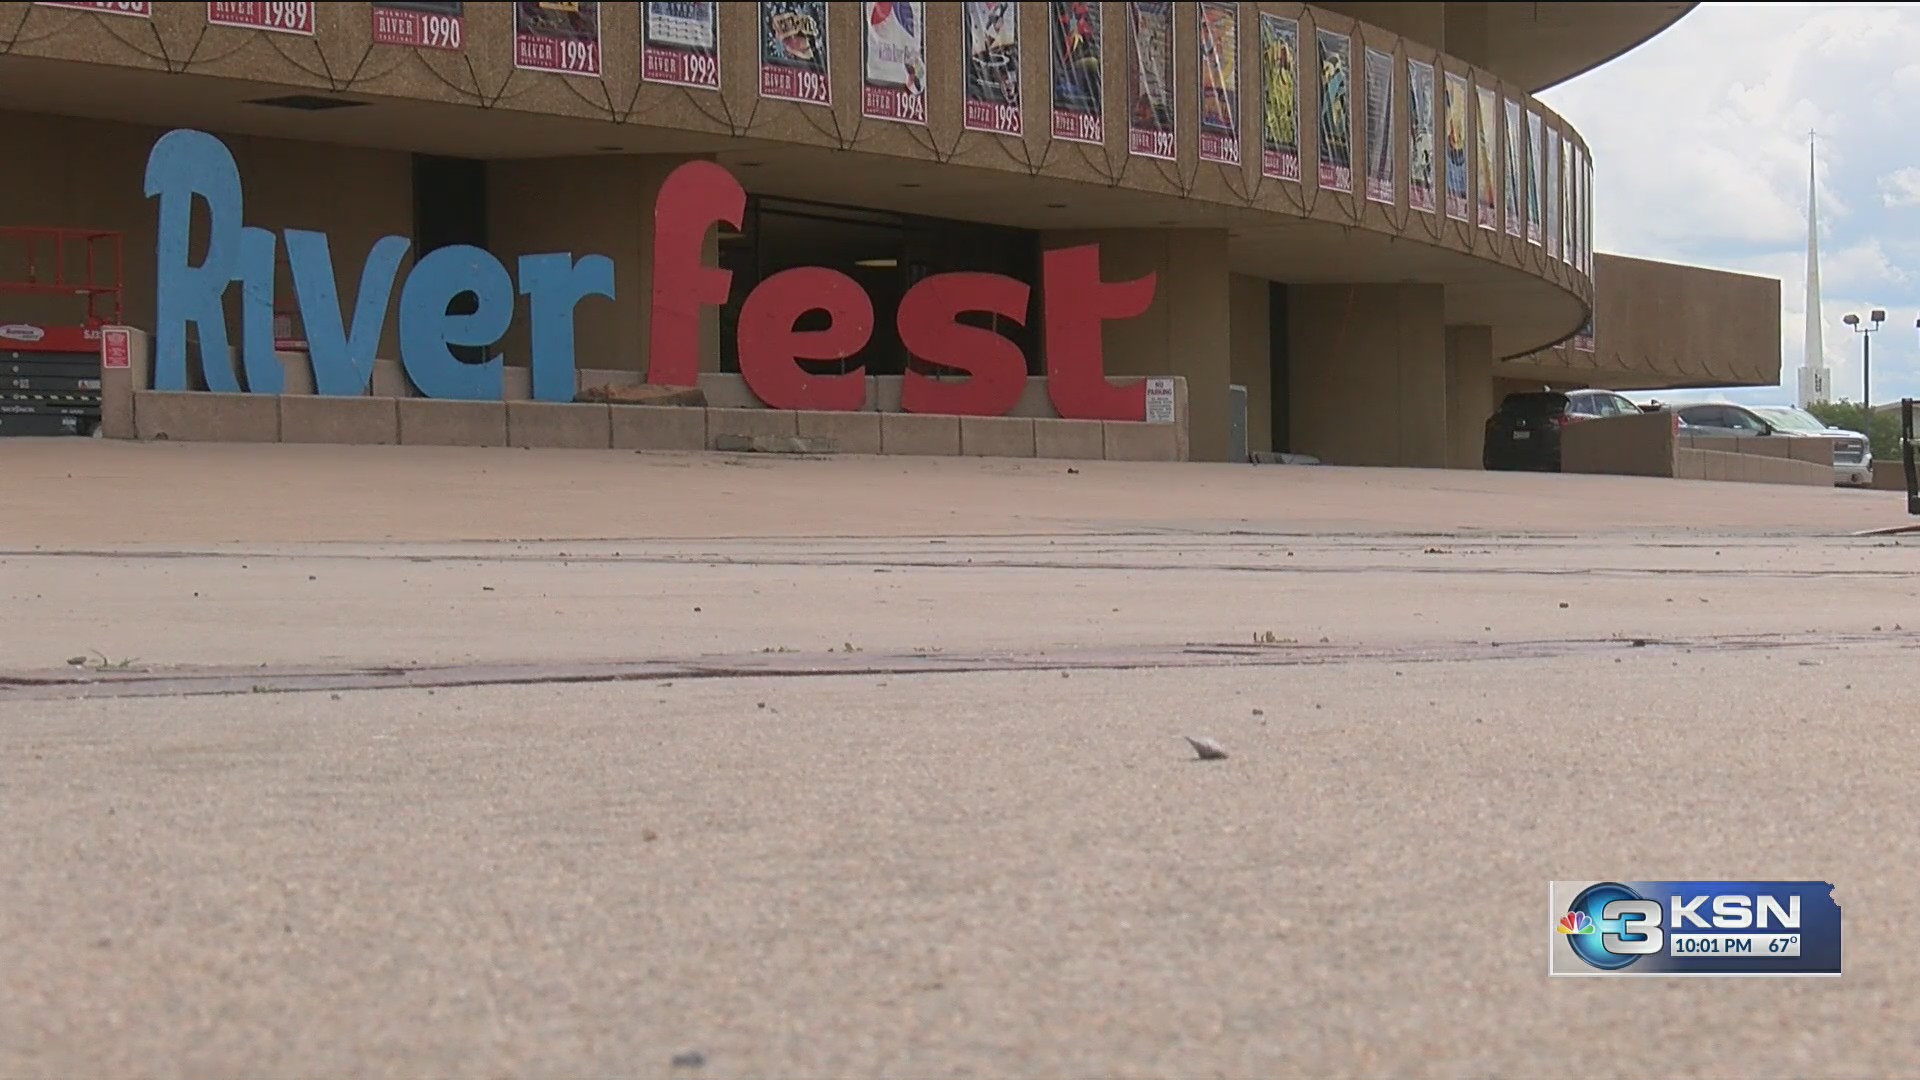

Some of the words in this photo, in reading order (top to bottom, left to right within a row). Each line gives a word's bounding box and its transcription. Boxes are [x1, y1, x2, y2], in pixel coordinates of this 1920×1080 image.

[217, 2, 254, 15] RIVER
[265, 2, 307, 29] 1989
[379, 17, 413, 35] RIVER
[422, 15, 460, 48] 1990
[521, 41, 552, 59] RIVER
[560, 40, 594, 71] 1991
[648, 55, 676, 72] RIVER
[683, 54, 717, 84] 1992
[764, 72, 791, 90] RIVER
[798, 71, 827, 101] 1993
[896, 92, 924, 120] 1994
[995, 104, 1019, 132] 1995
[1079, 115, 1102, 140] 1996
[1153, 131, 1174, 156] 1997
[1220, 138, 1239, 163] 1998
